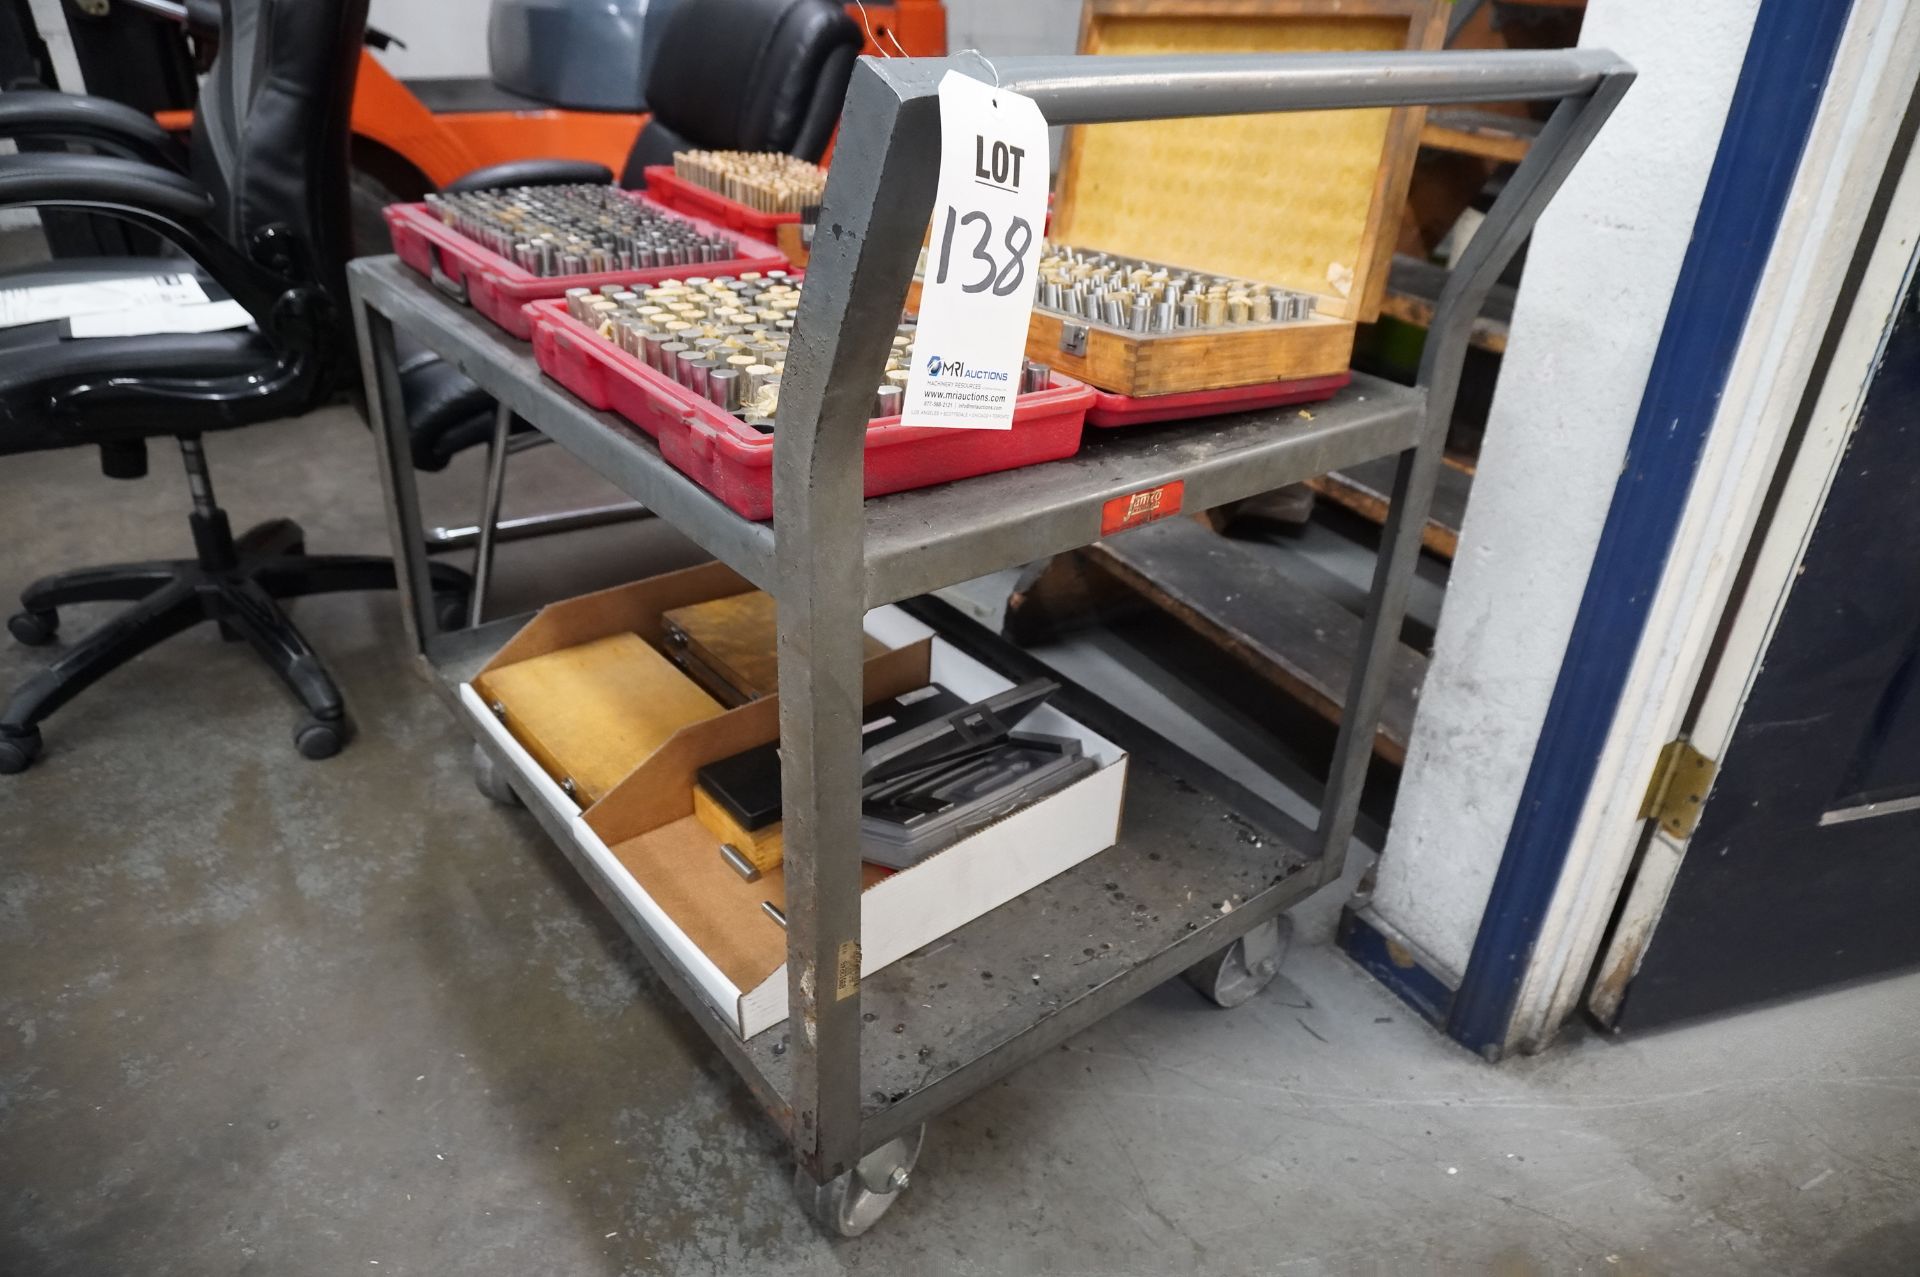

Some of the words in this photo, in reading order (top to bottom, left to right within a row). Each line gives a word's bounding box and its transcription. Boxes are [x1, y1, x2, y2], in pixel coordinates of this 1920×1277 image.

[976, 134, 1025, 188] LOT
[936, 205, 1032, 297] 138
[941, 361, 965, 377] MRI
[964, 369, 1008, 381] AUCTIONS
[924, 390, 1006, 403] www.mriauctions.com
